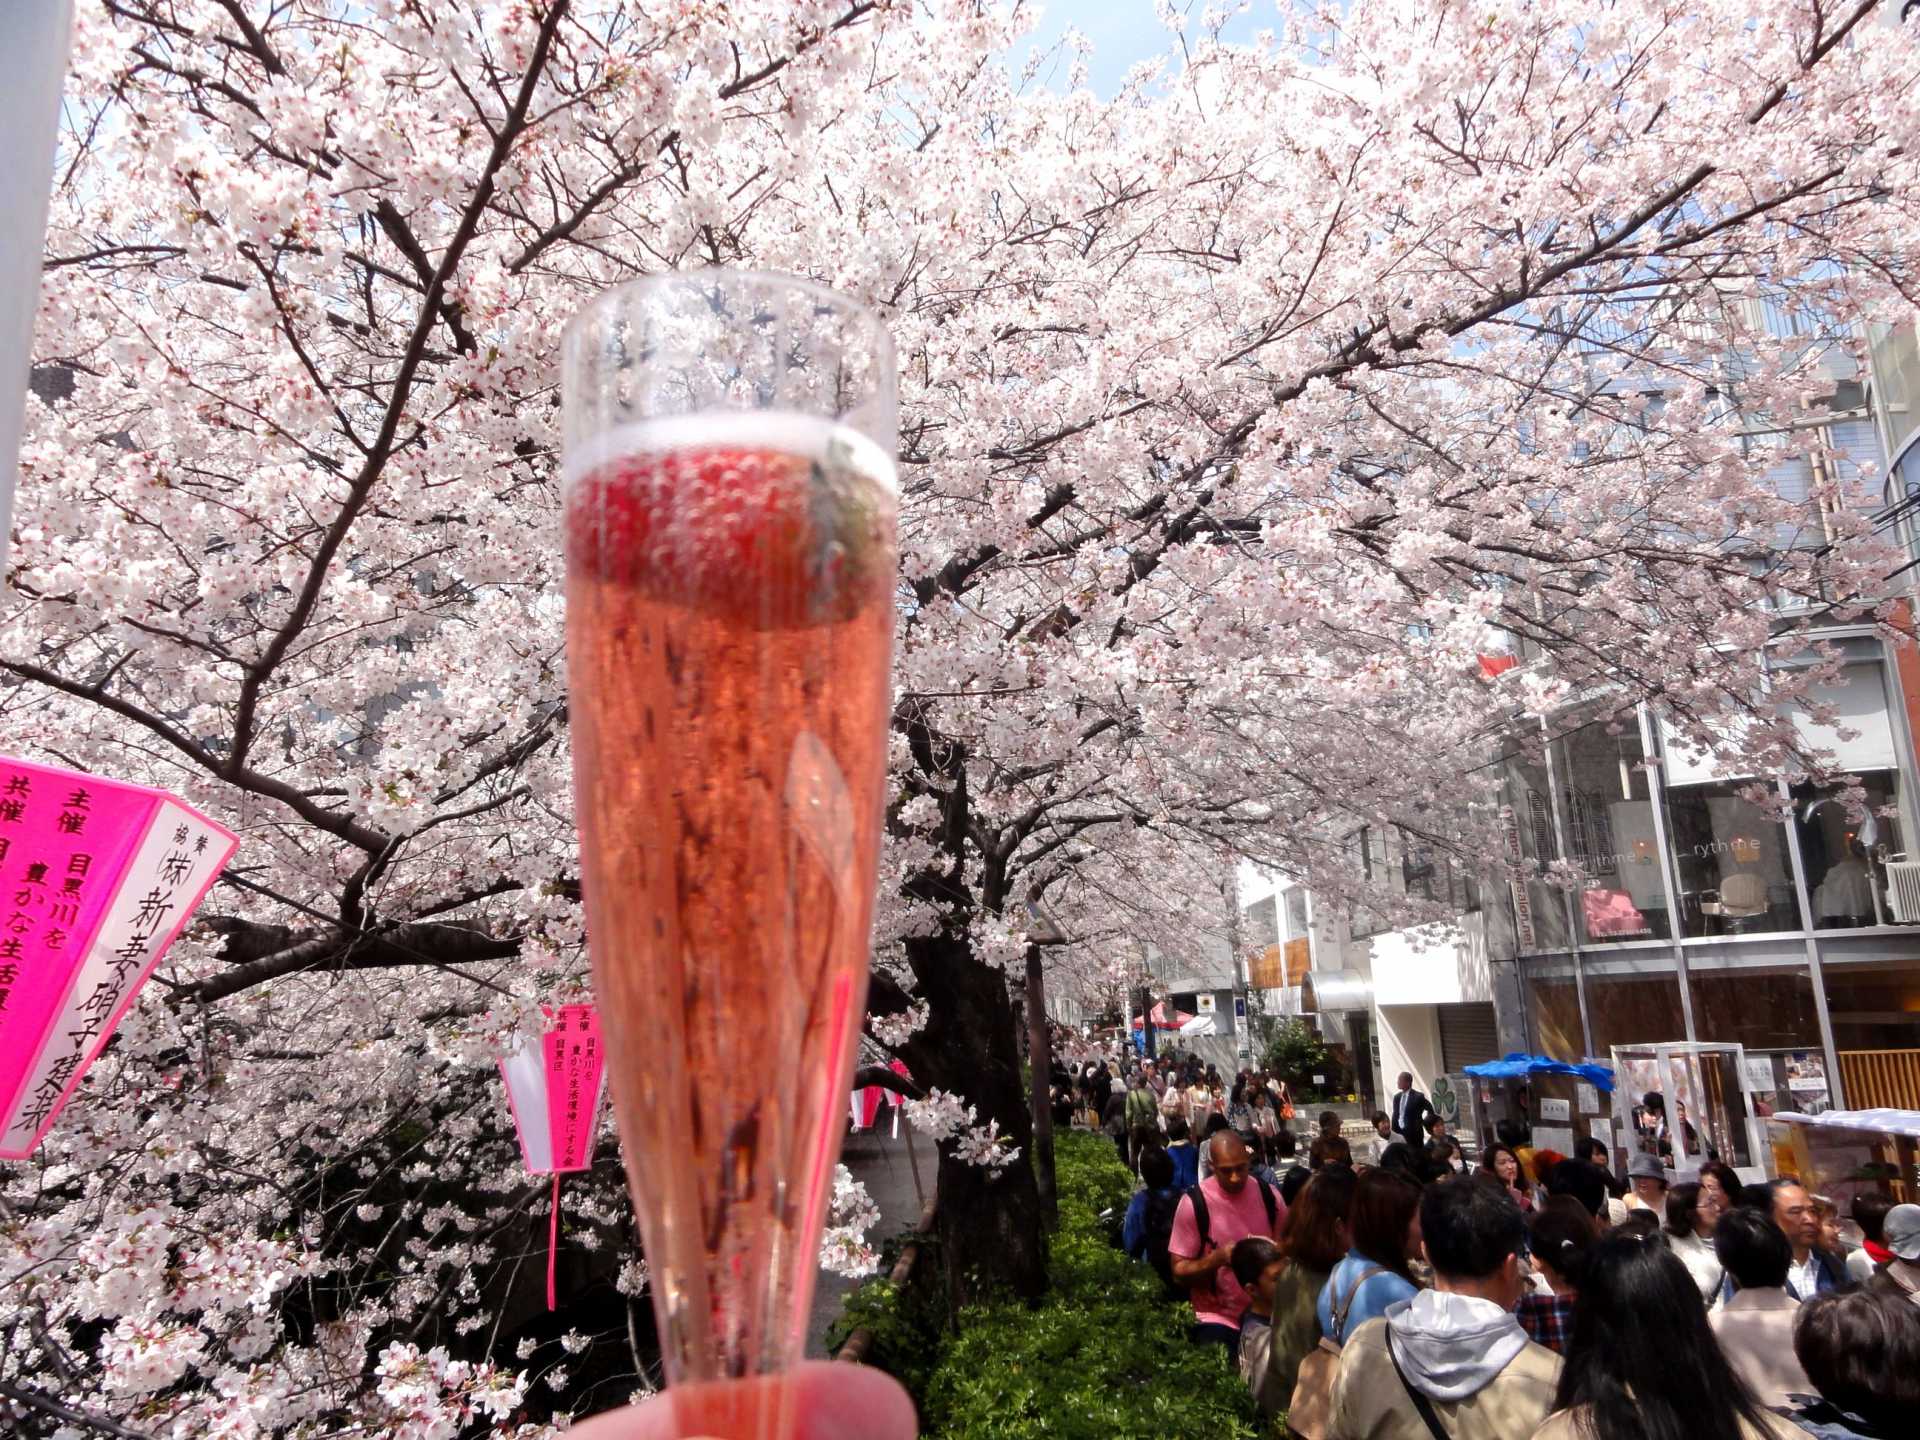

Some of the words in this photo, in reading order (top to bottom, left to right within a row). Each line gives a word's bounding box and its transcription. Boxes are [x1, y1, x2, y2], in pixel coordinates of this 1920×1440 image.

[56, 787, 93, 836] 主催
[1693, 836, 1761, 859] rythme
[42, 852, 93, 950] 目黒川を
